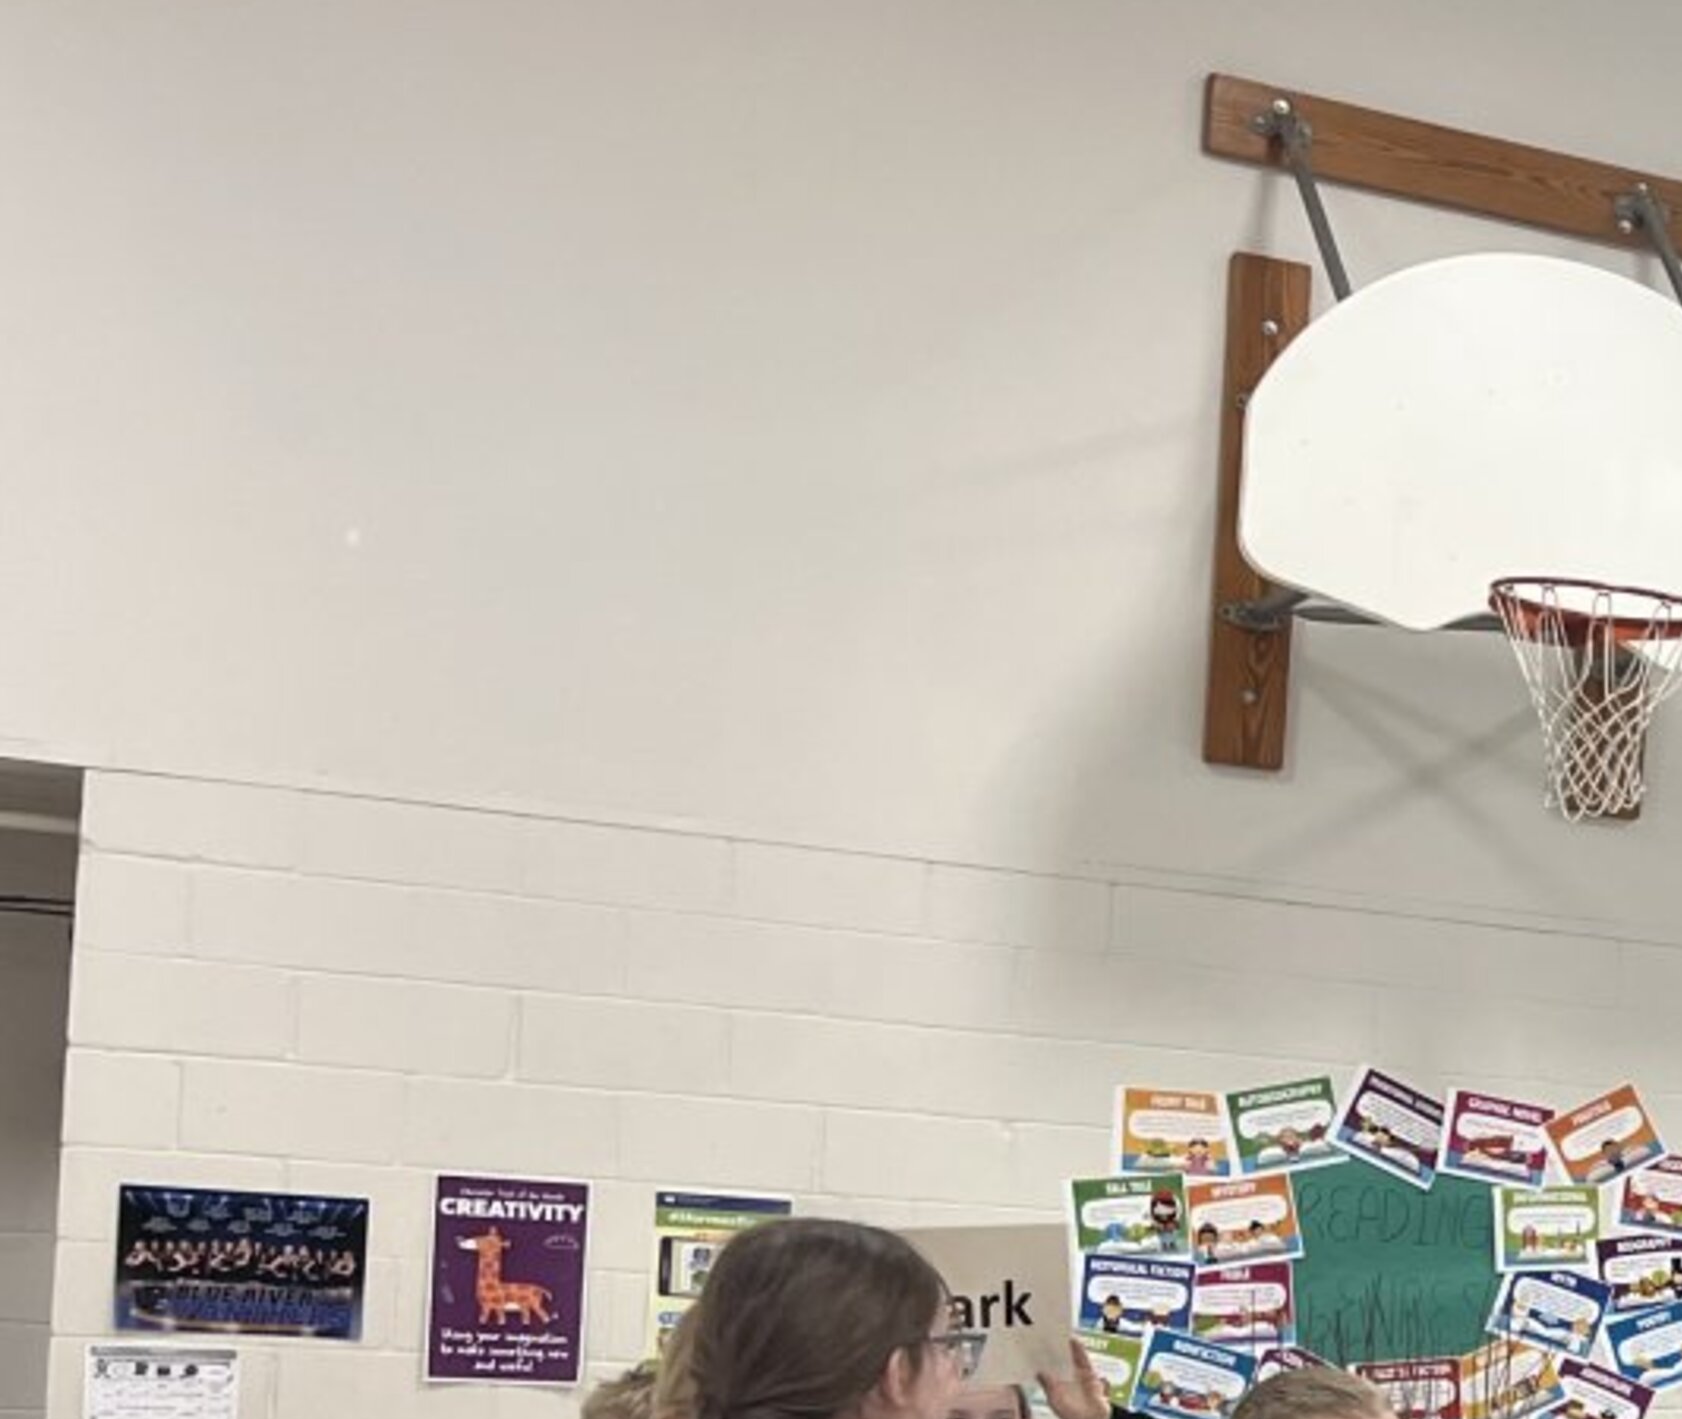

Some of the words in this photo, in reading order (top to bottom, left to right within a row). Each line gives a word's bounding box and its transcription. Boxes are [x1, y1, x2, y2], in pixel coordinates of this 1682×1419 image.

[440, 1197, 584, 1223] CREATIVITY
[1300, 1184, 1489, 1248] READING
[948, 1279, 1034, 1329] ark
